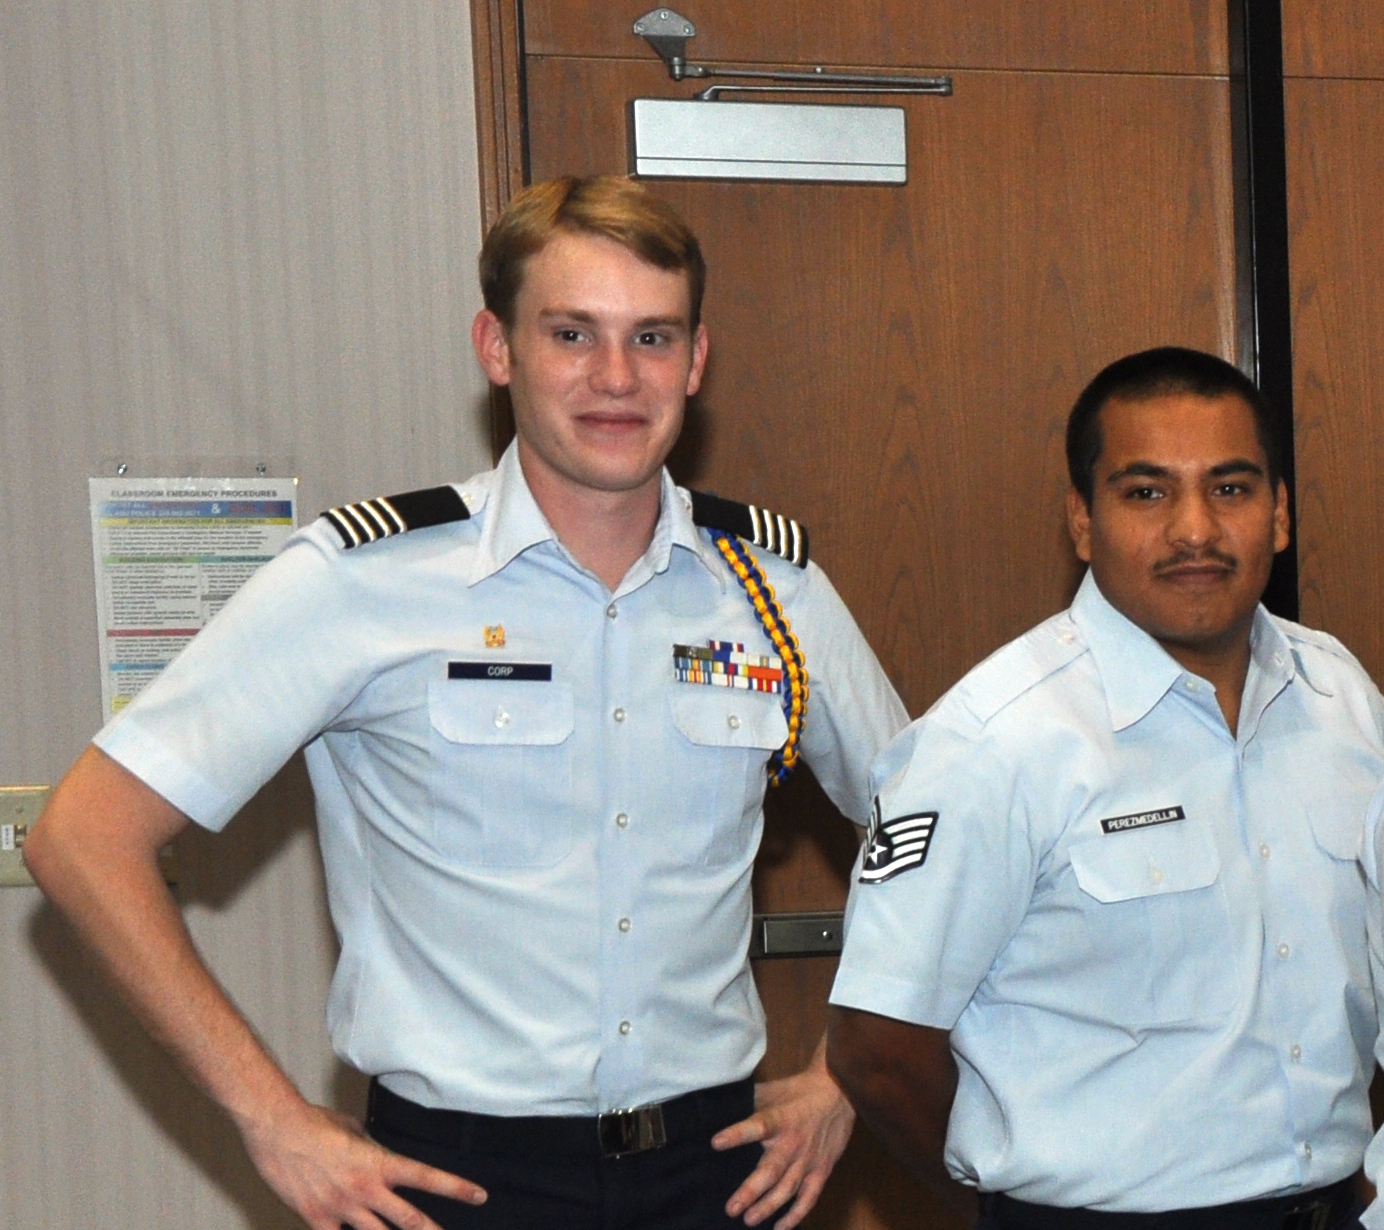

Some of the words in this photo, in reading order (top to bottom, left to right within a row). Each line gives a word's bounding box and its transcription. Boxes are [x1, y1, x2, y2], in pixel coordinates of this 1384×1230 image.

[166, 490, 218, 498] EMERGENCY
[220, 490, 278, 498] PROCEDURES
[487, 665, 514, 677] CORP
[1108, 809, 1178, 830] PEREZMEDELLIN
